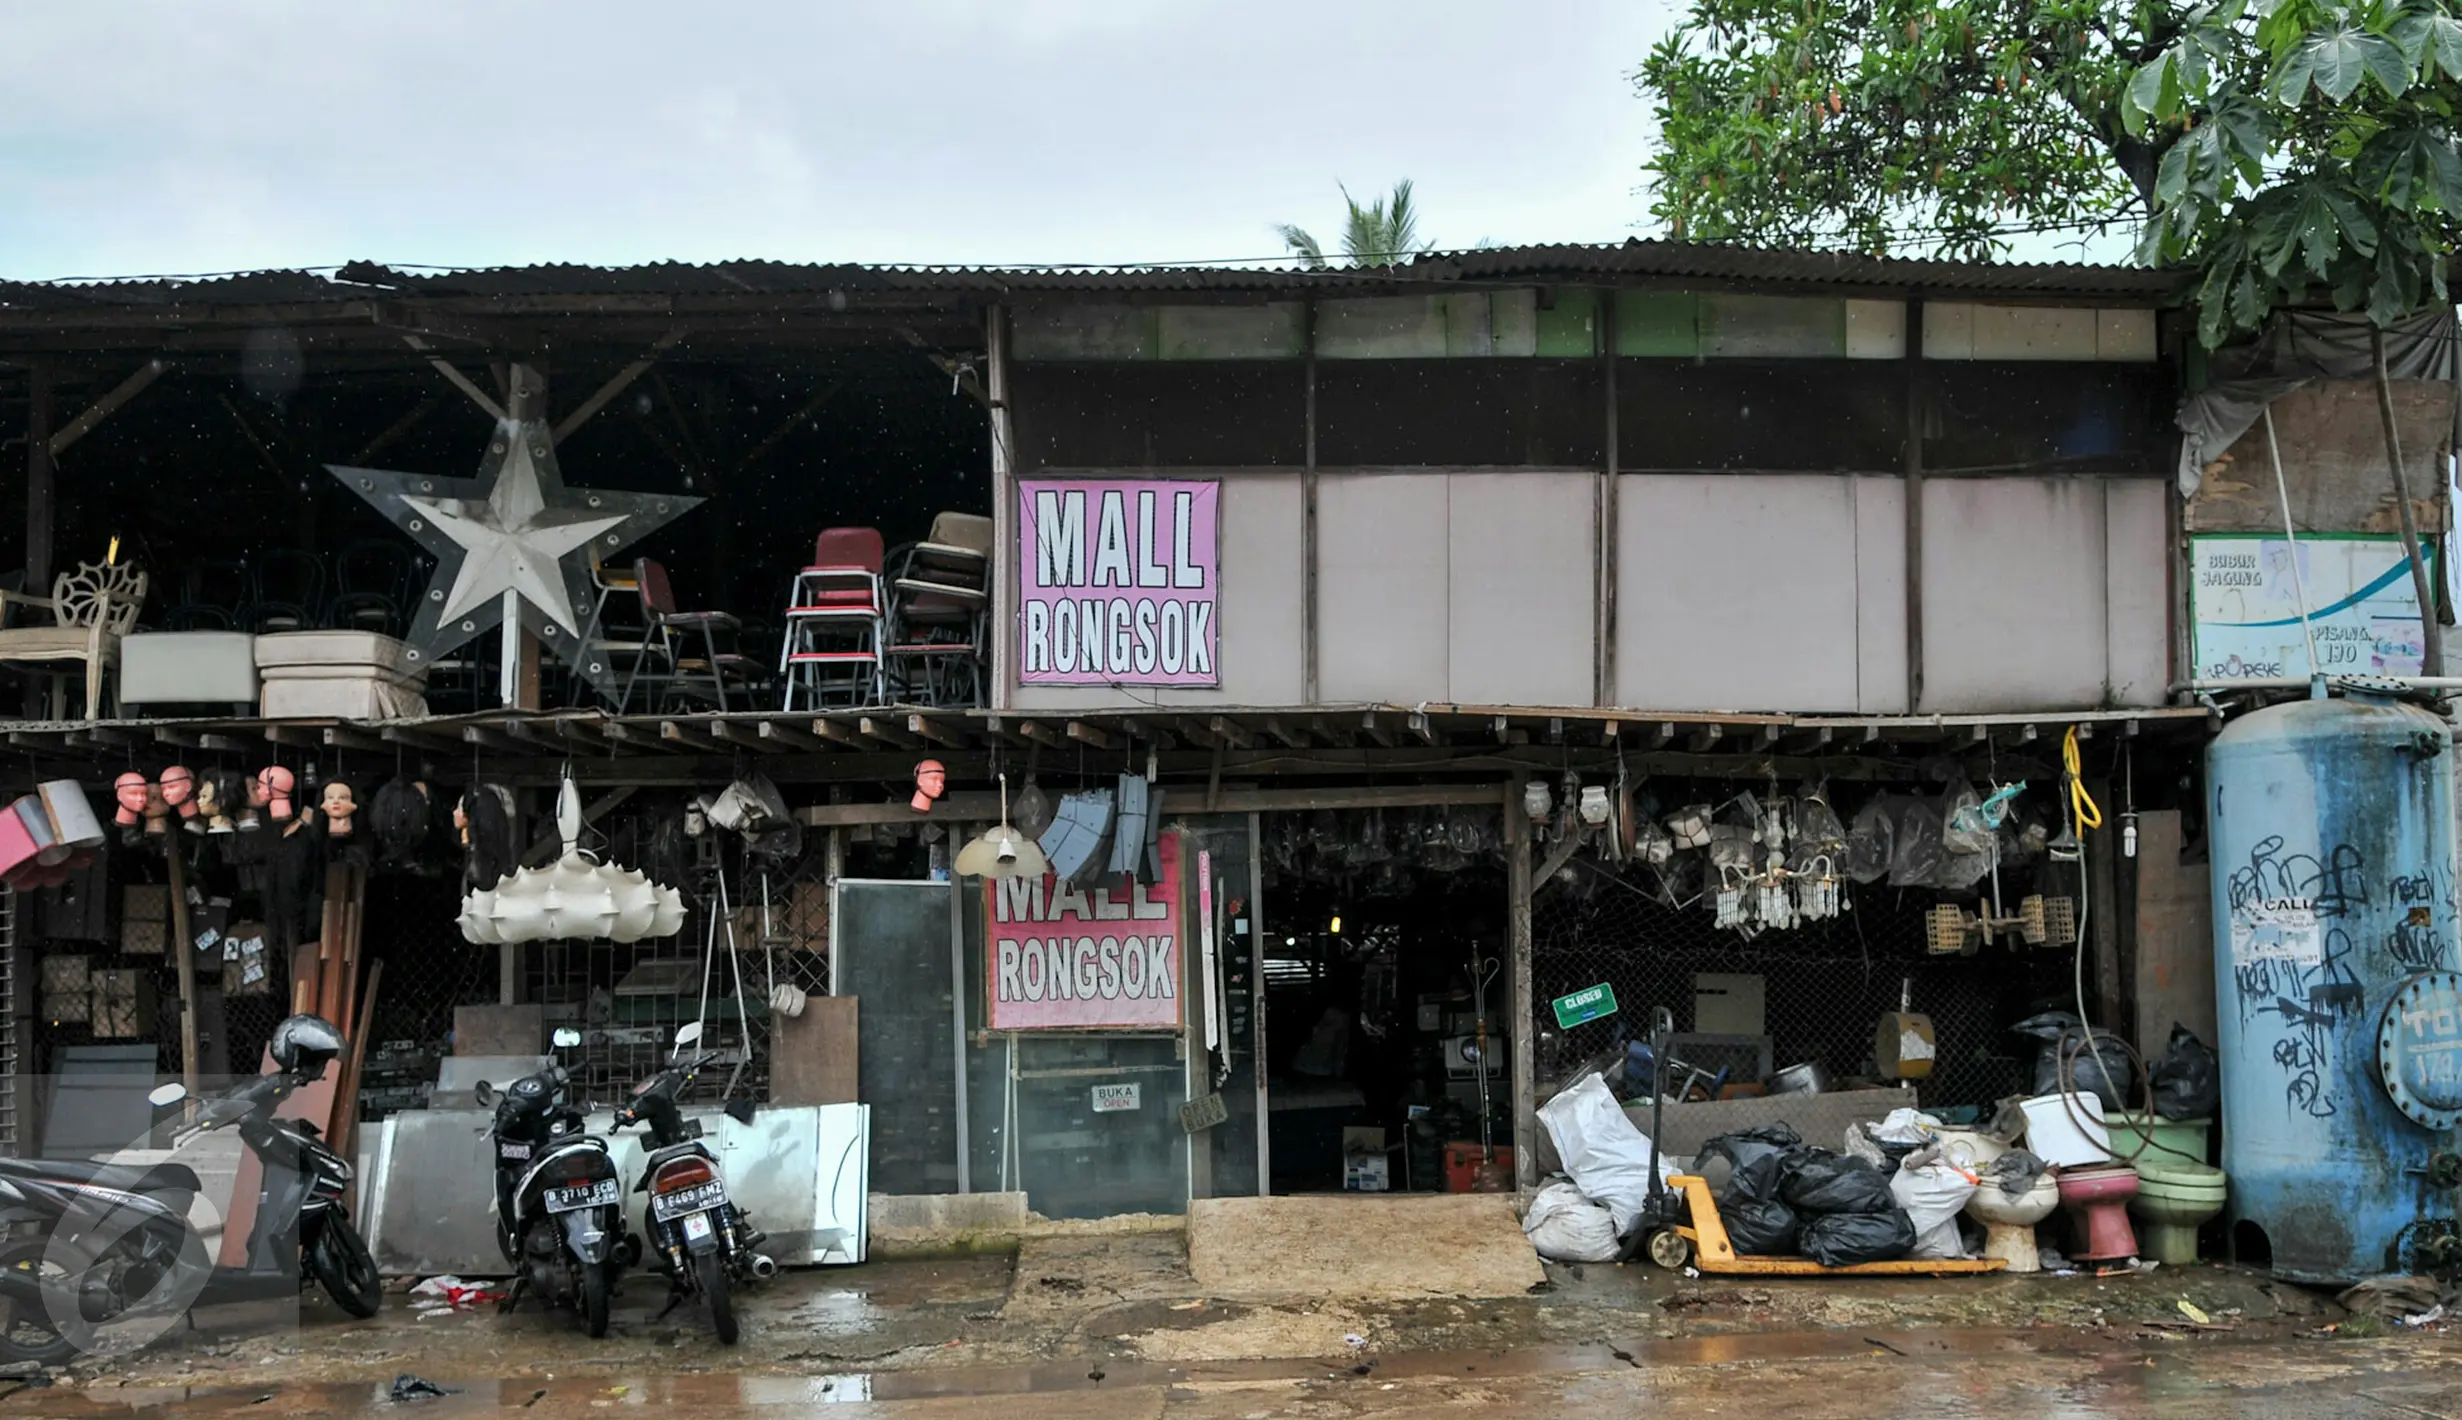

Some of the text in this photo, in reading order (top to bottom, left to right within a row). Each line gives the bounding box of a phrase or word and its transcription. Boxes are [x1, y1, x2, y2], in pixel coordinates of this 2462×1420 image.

[1035, 490, 1205, 589] MALL
[2208, 554, 2257, 569] BUBUR
[2202, 570, 2263, 587] JAGUNG
[1025, 597, 1213, 675] RONGSOK
[997, 935, 1174, 1002] RONGSOK
[1565, 988, 1603, 1009] CLOSED
[1098, 1086, 1133, 1098] BUKA
[1103, 1098, 1131, 1108] OPEN
